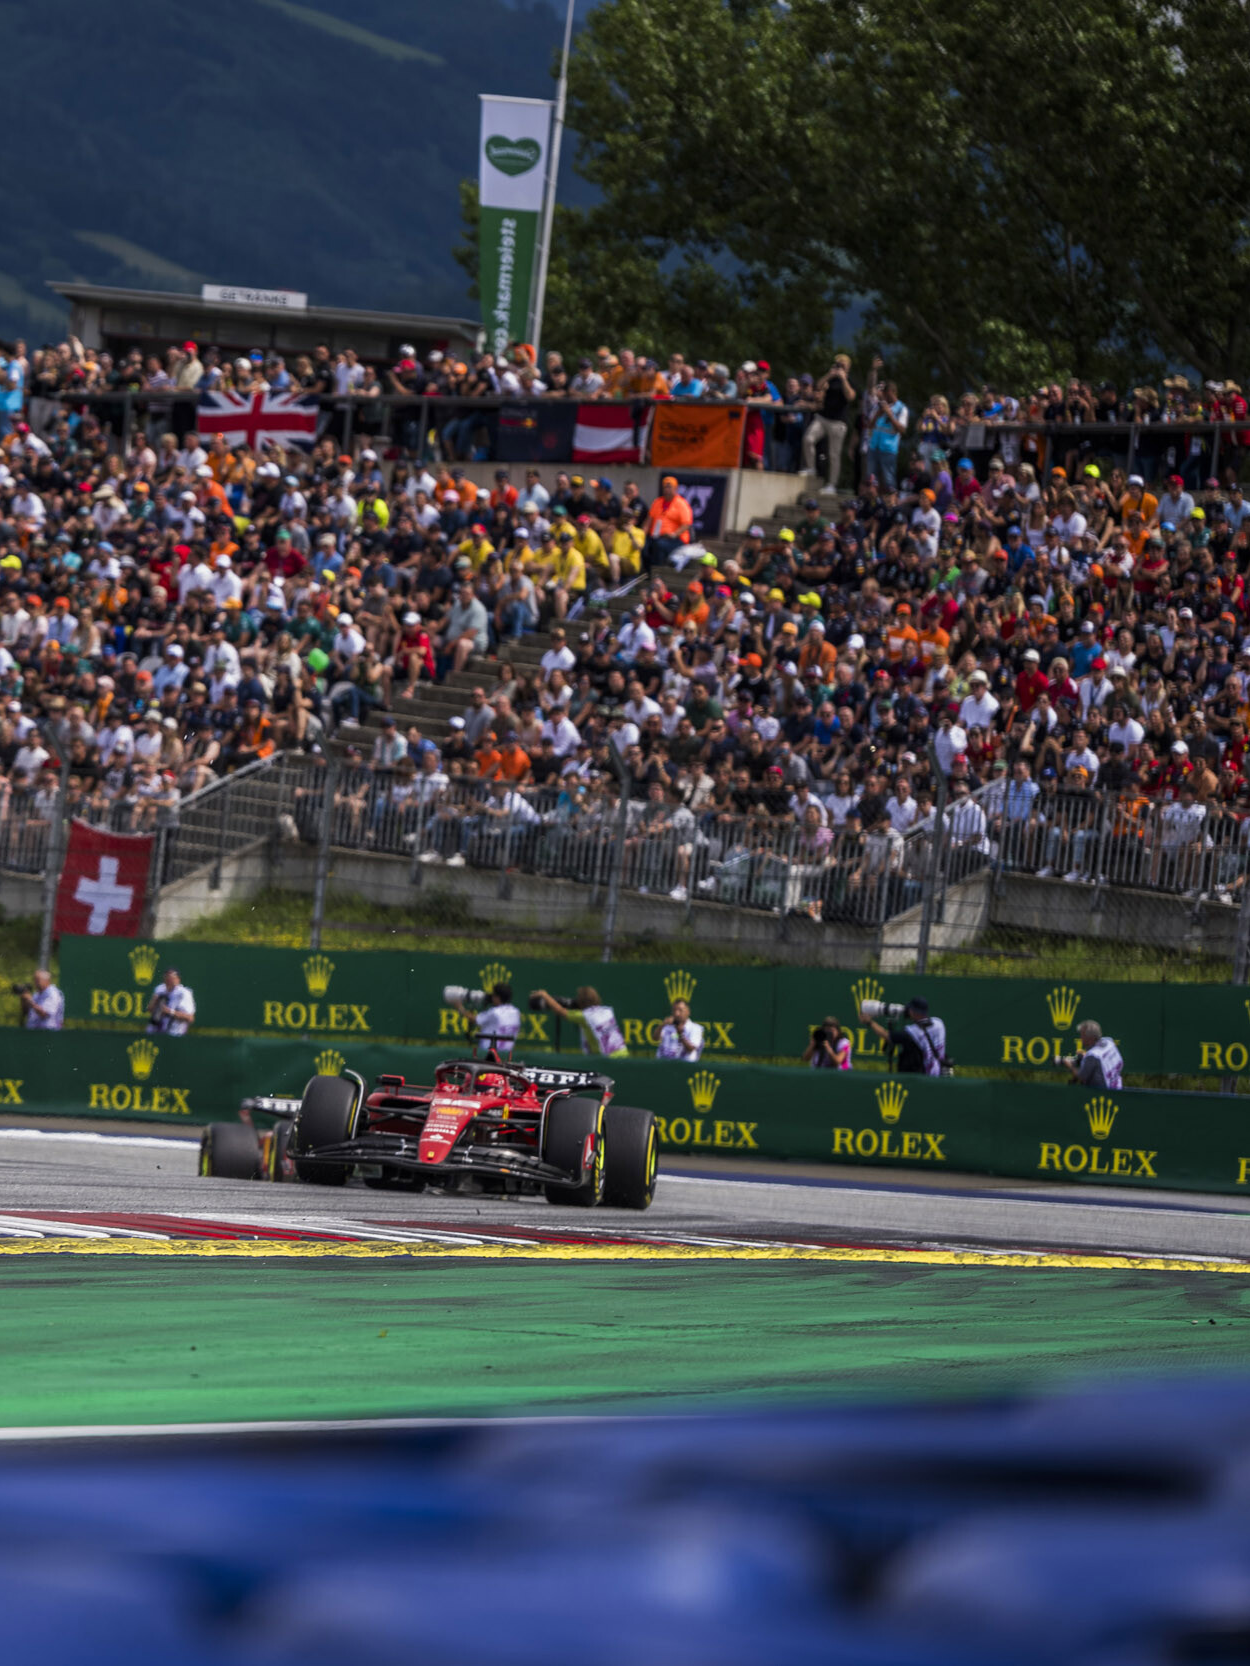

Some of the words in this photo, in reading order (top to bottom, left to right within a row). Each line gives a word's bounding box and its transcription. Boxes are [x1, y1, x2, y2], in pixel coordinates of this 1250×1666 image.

[90, 989, 152, 1018] ROL
[263, 1001, 370, 1032] ROLEX
[622, 1018, 735, 1049] ROEX
[1001, 1035, 1121, 1065] ROL
[89, 1084, 191, 1115] ROLEX
[654, 1117, 758, 1149] ROLEX
[832, 1127, 946, 1161] ROLEX
[1038, 1142, 1158, 1178] ROLEX
